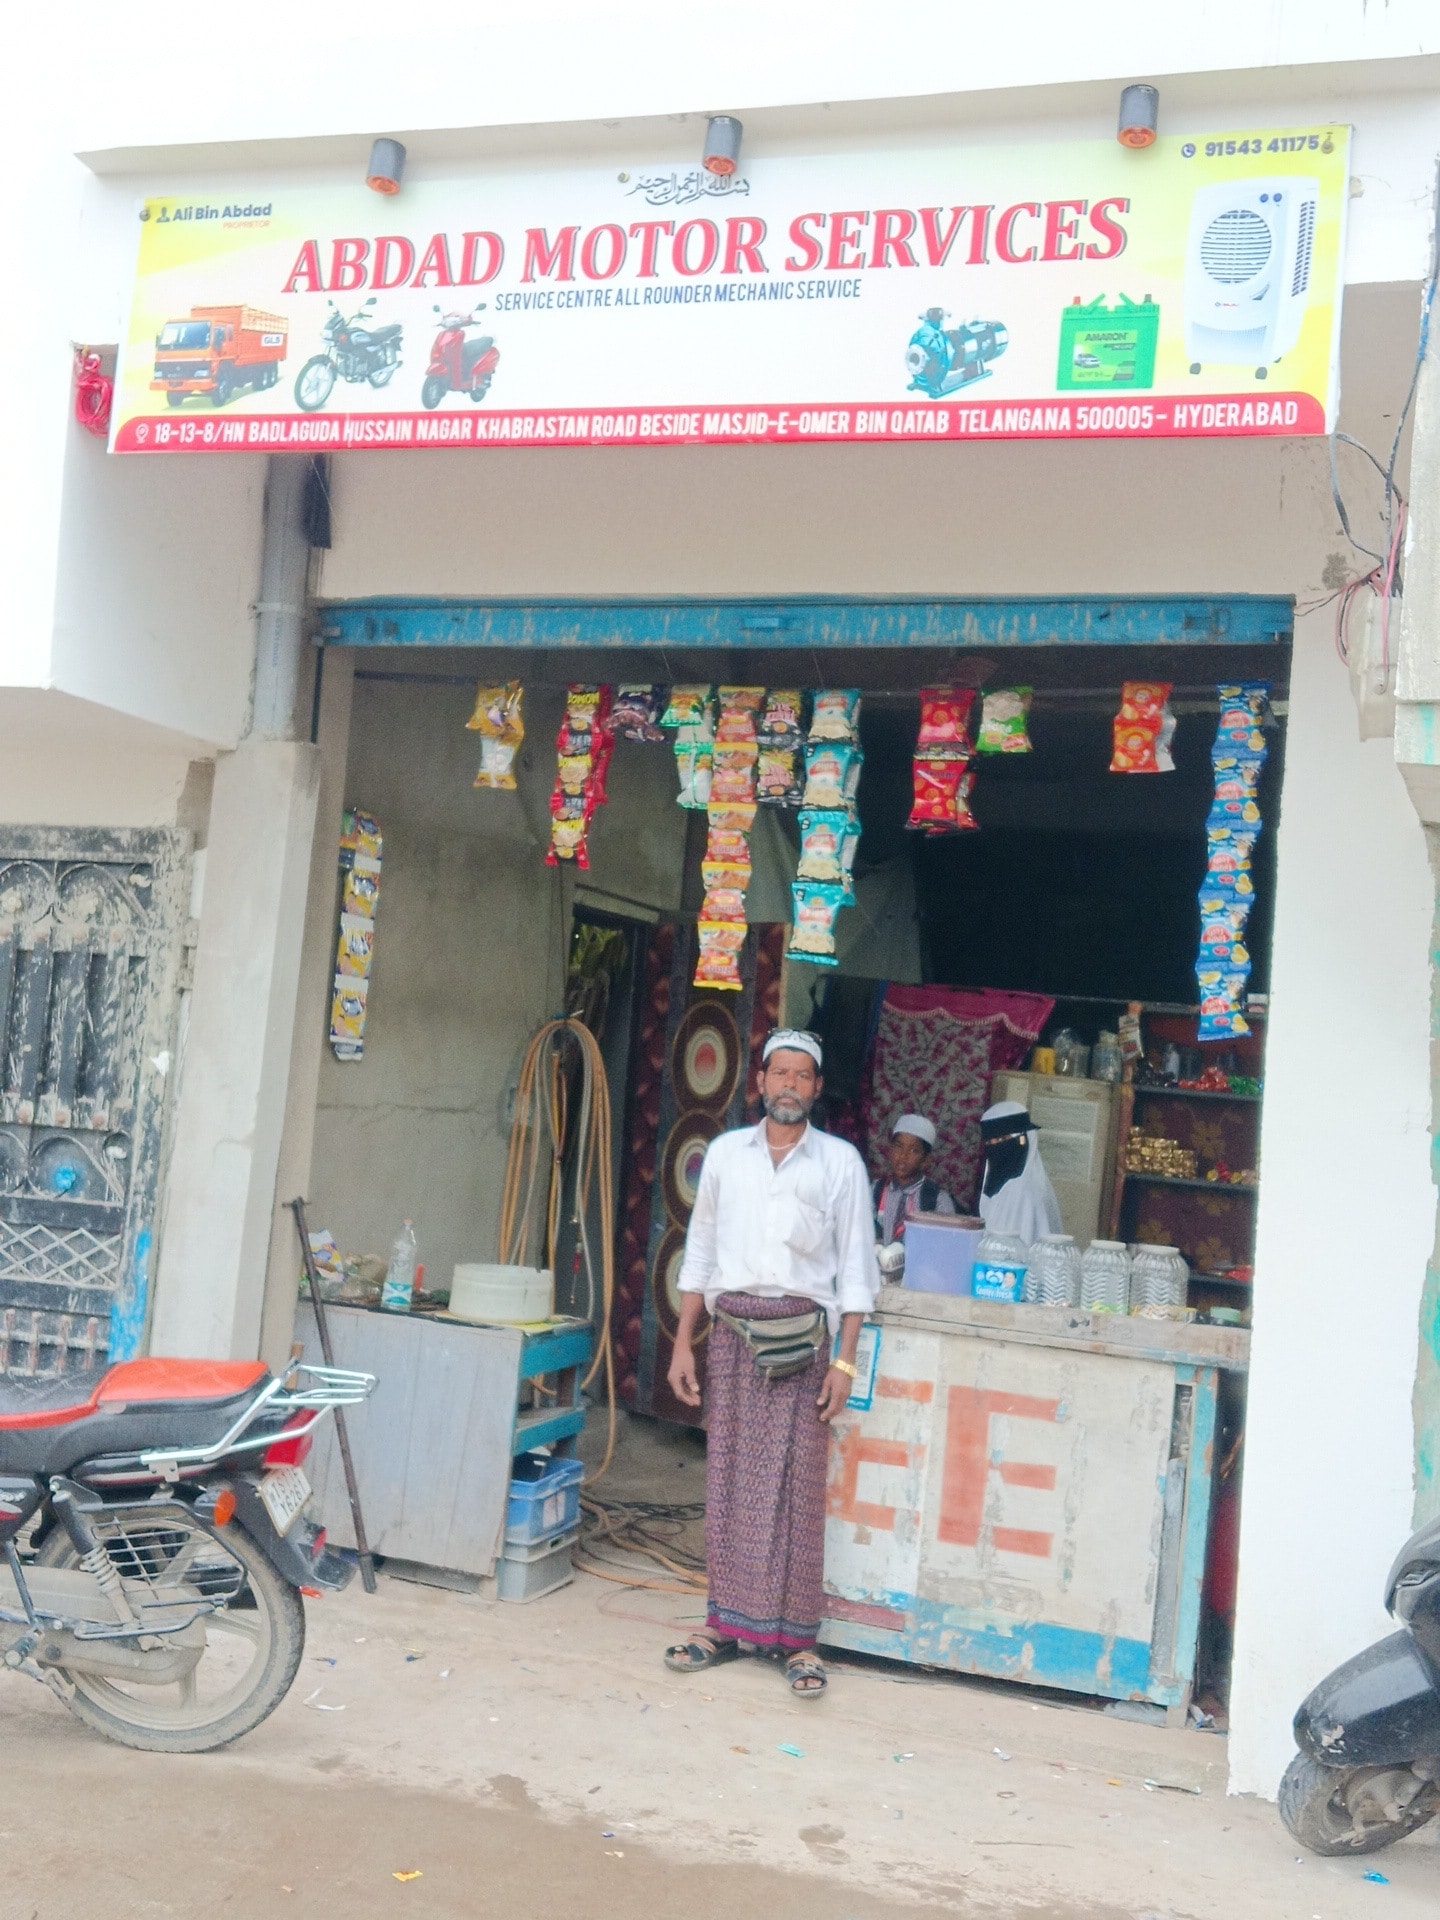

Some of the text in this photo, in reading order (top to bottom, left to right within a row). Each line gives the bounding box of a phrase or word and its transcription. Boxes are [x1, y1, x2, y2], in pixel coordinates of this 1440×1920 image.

[1205, 134, 1320, 157] 91543 41175
[172, 203, 272, 221] Ali Bin Abdad
[281, 197, 1130, 293] ABDAD MOTOR SERVICES
[495, 278, 862, 311] SERVICE CENTRE ALL ROUNDER MECHANIC SERVICE
[154, 421, 246, 444] 18-13-8/HN
[249, 420, 340, 443] BADLAGUDA
[342, 418, 412, 442] HUSSAIN
[416, 418, 472, 441] NAGAR
[476, 415, 589, 440] KHABRASTAN
[591, 415, 637, 438] ROAD
[639, 412, 700, 437] BESIDE
[703, 411, 850, 436] MASJID-E-OMER
[855, 411, 887, 434] BIN
[890, 410, 949, 433] QATAB
[959, 406, 1071, 432] TELANGANA
[1173, 401, 1298, 428] HYDERABAD
